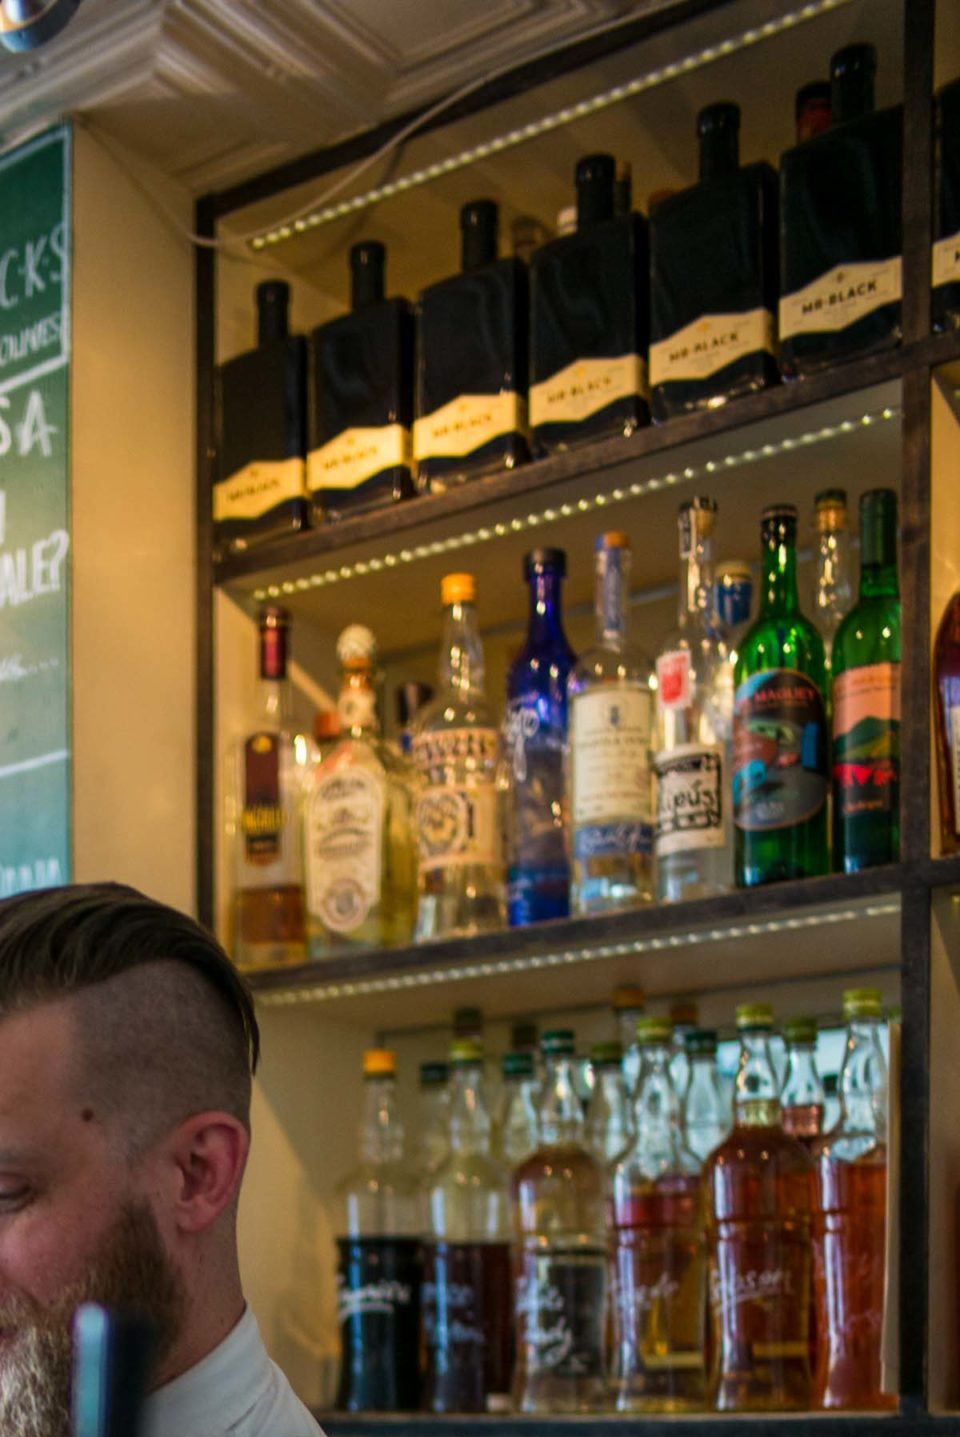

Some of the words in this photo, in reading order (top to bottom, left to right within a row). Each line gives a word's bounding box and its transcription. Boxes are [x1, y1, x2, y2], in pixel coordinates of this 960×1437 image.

[800, 299, 824, 315] MR
[828, 280, 878, 307] BLACK
[15, 389, 58, 458] A
